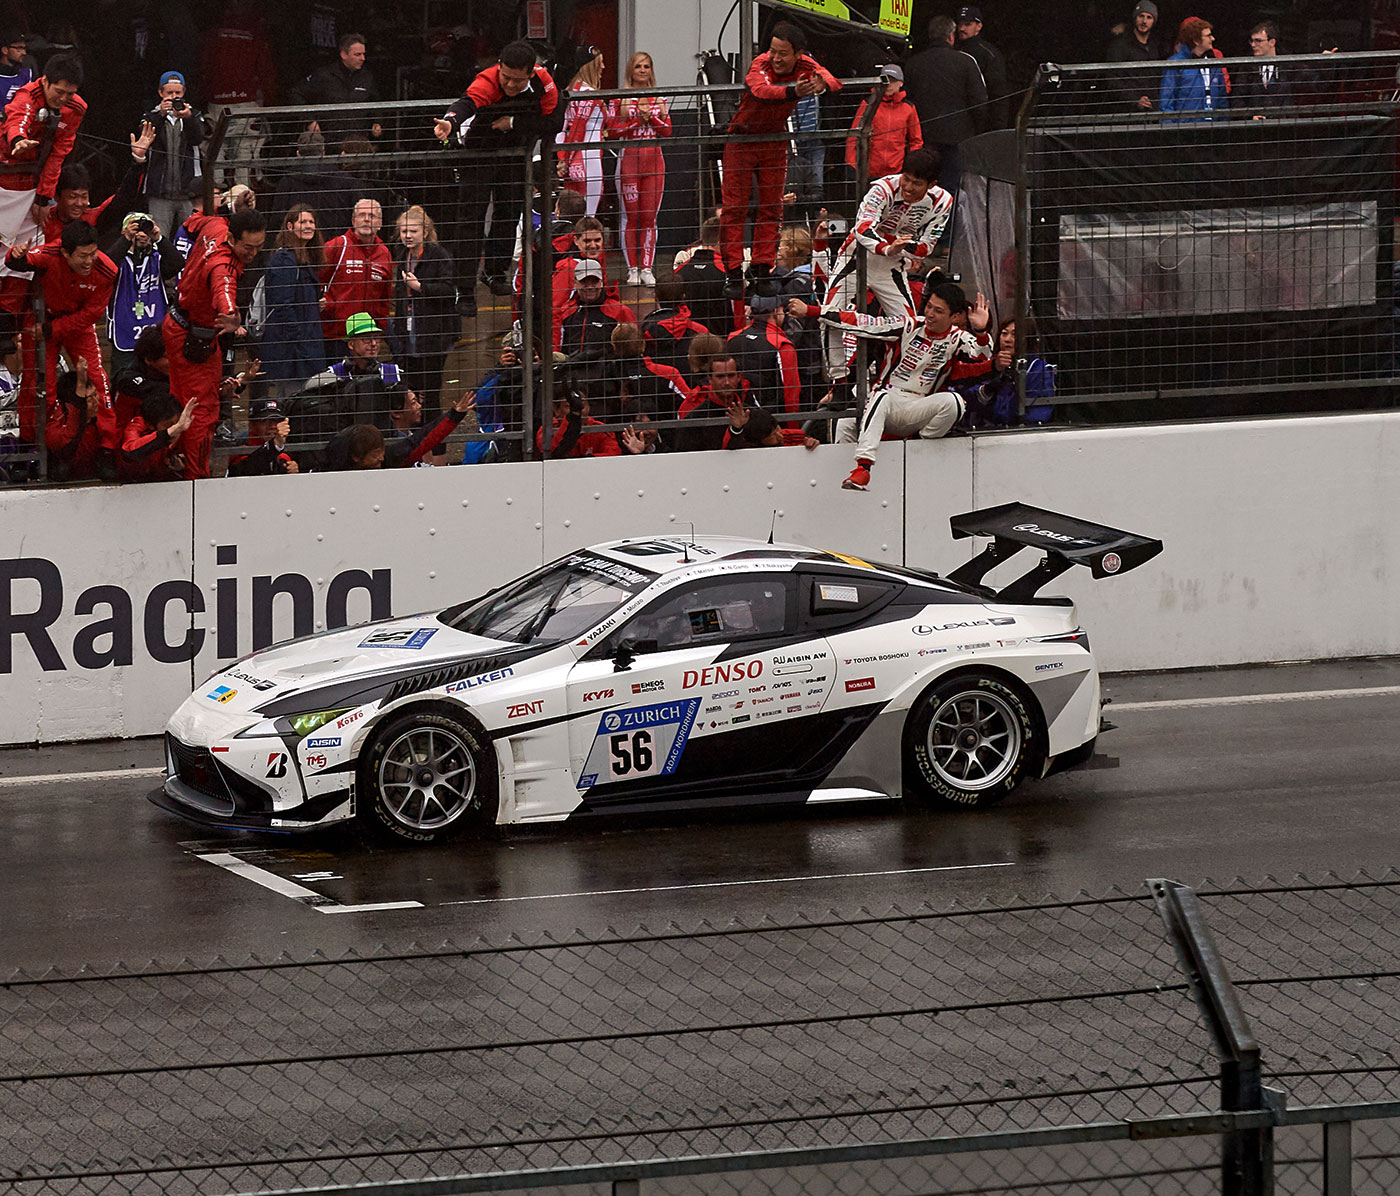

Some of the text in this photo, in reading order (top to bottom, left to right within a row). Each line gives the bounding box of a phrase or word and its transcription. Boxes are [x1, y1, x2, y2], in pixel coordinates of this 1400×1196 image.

[1031, 528, 1072, 542] LEXUS
[587, 618, 616, 641] YAZAKI
[932, 619, 989, 631] LEXUS
[787, 653, 811, 663] AISIN
[853, 651, 909, 664] TOYOTA BOSHOKU
[1034, 662, 1063, 671] GENTEX
[445, 667, 514, 694] FALKEN
[682, 659, 763, 689] DENSO
[641, 680, 665, 689] ENEOS
[748, 685, 766, 693] TOM'S
[583, 688, 614, 702] KYB
[506, 700, 544, 718] ZENT
[624, 706, 680, 727] ZURICH
[415, 714, 480, 752] BRIDGESTONE
[666, 699, 697, 773] ADAC NORDRHEIN
[609, 729, 653, 776] 56
[915, 744, 980, 805] BRIDGESTONE
